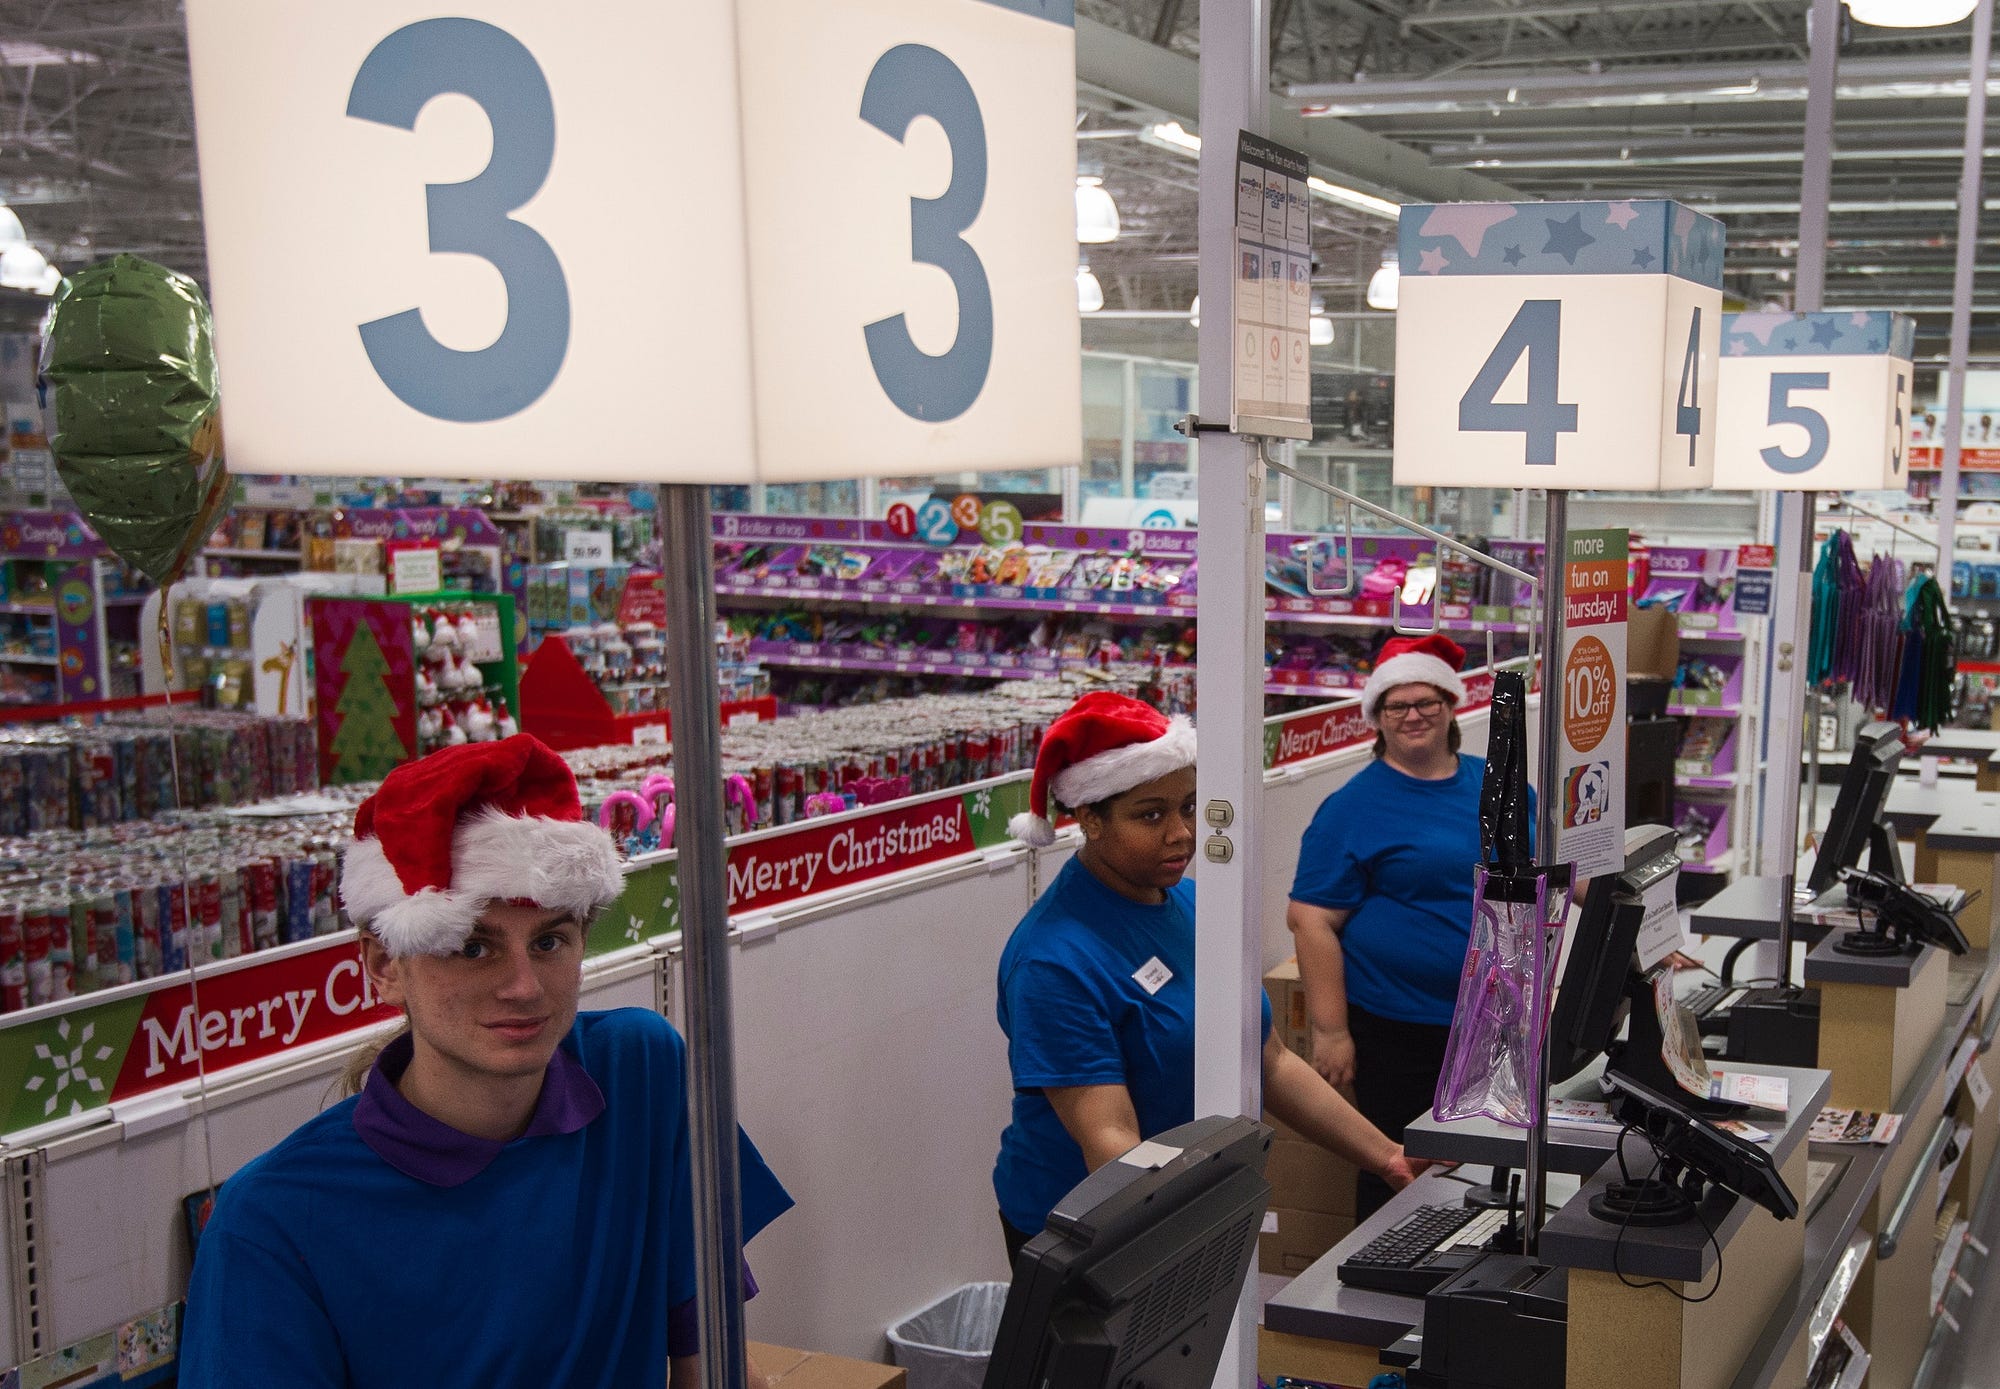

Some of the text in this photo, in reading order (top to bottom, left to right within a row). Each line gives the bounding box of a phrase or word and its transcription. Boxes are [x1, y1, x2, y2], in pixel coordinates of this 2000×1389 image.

[346, 17, 572, 423] 3
[858, 43, 994, 423] 3
[1458, 299, 1579, 465] 4
[1676, 306, 1701, 467] 4
[1759, 372, 1831, 475] 5
[1892, 373, 1905, 475] 5
[22, 522, 66, 547] Candy
[354, 518, 394, 539] Candy
[1573, 538, 1604, 556] more
[1650, 553, 1690, 570] shop
[1571, 564, 1609, 589] fun on
[1278, 727, 1322, 761] Merry
[1592, 693, 1611, 716] off
[728, 802, 963, 905] Merry Christmas!
[142, 989, 317, 1078] Merry
